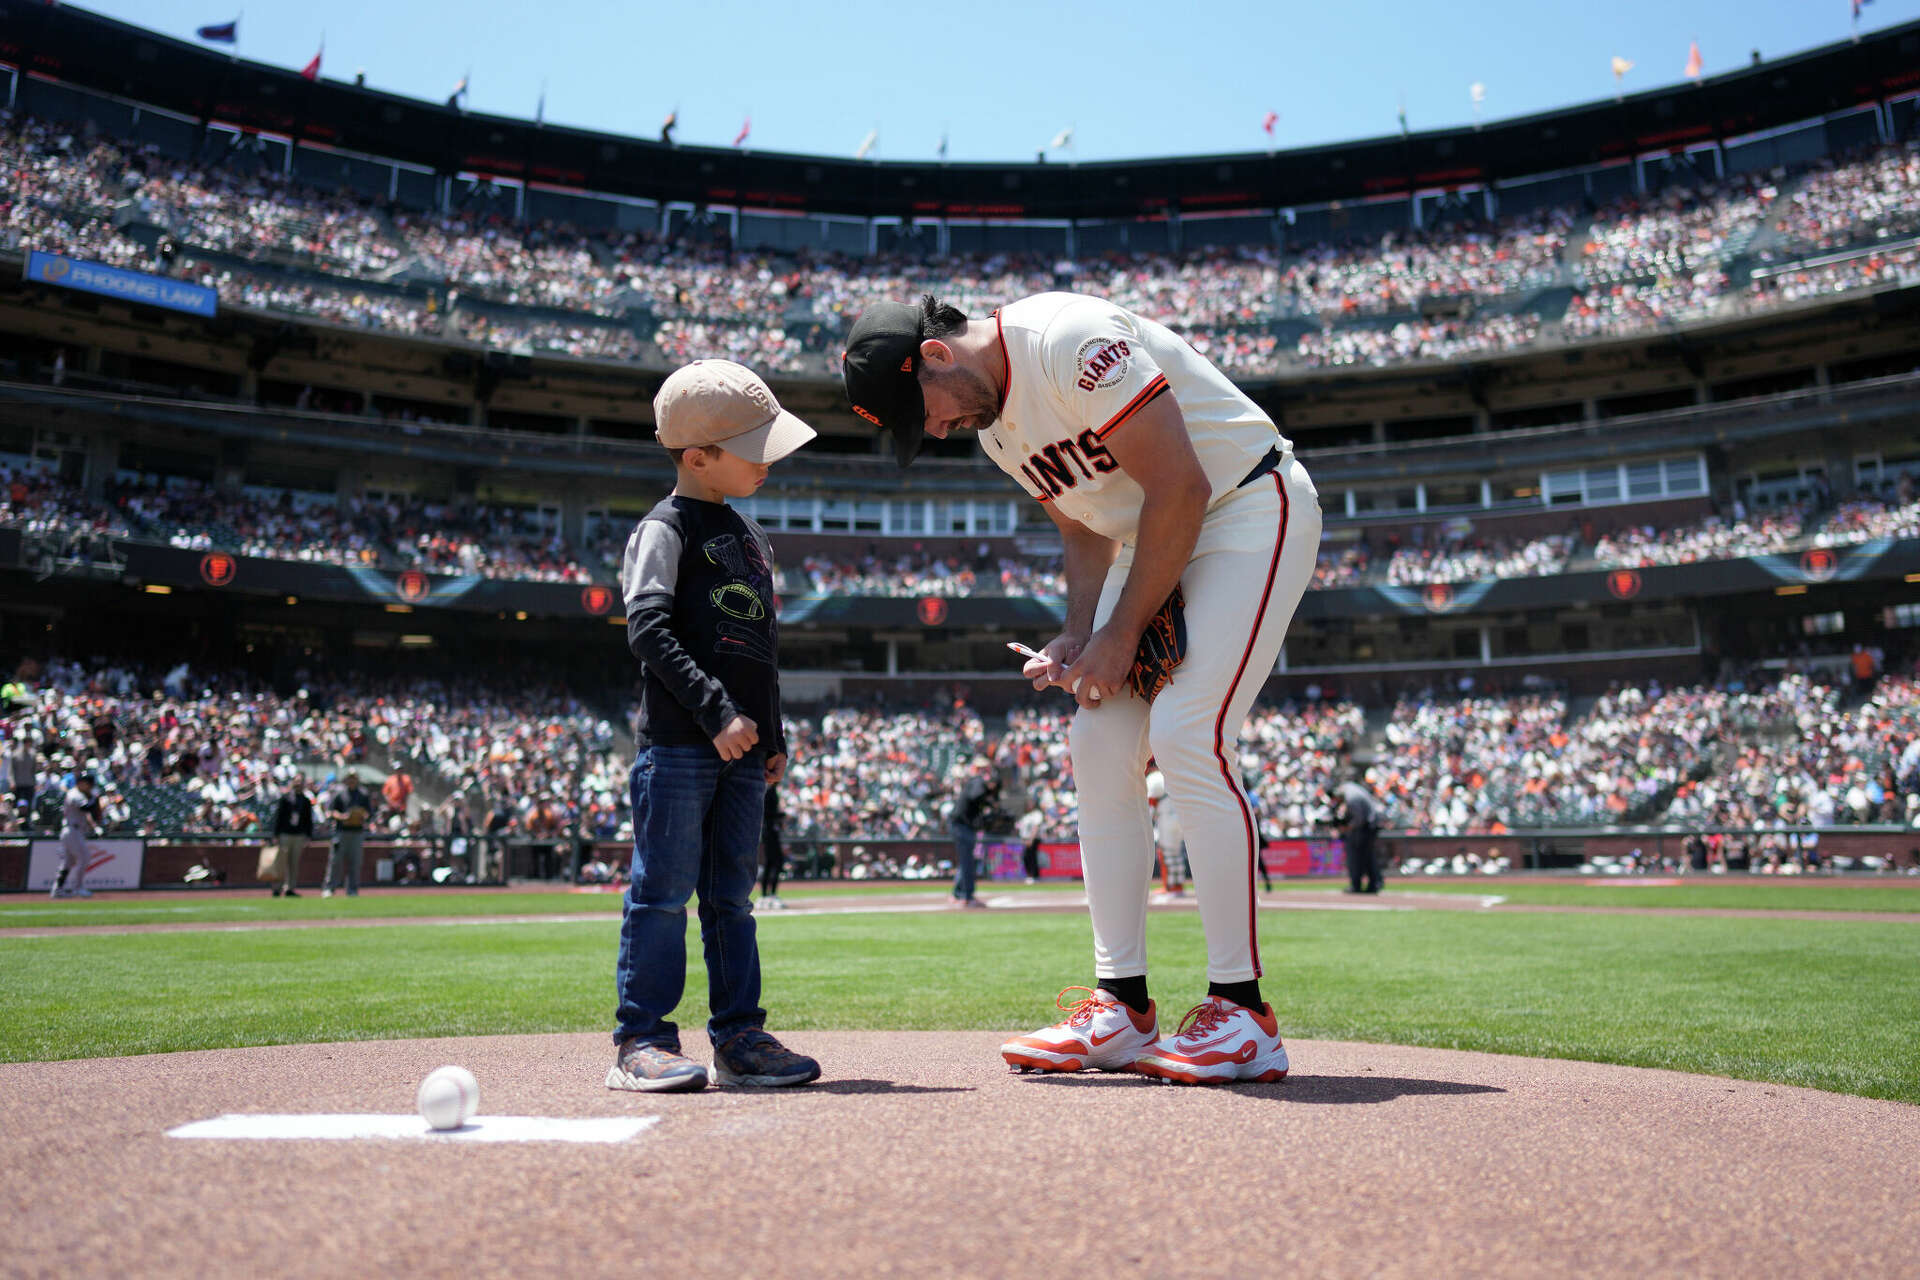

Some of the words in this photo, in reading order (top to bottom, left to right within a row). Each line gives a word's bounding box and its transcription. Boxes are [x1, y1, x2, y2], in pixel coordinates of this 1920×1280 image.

[160, 288, 204, 308] LAW
[1079, 338, 1111, 356] FRANCISCO
[1078, 340, 1130, 392] GIANTS
[1097, 374, 1124, 389] BASEBALL
